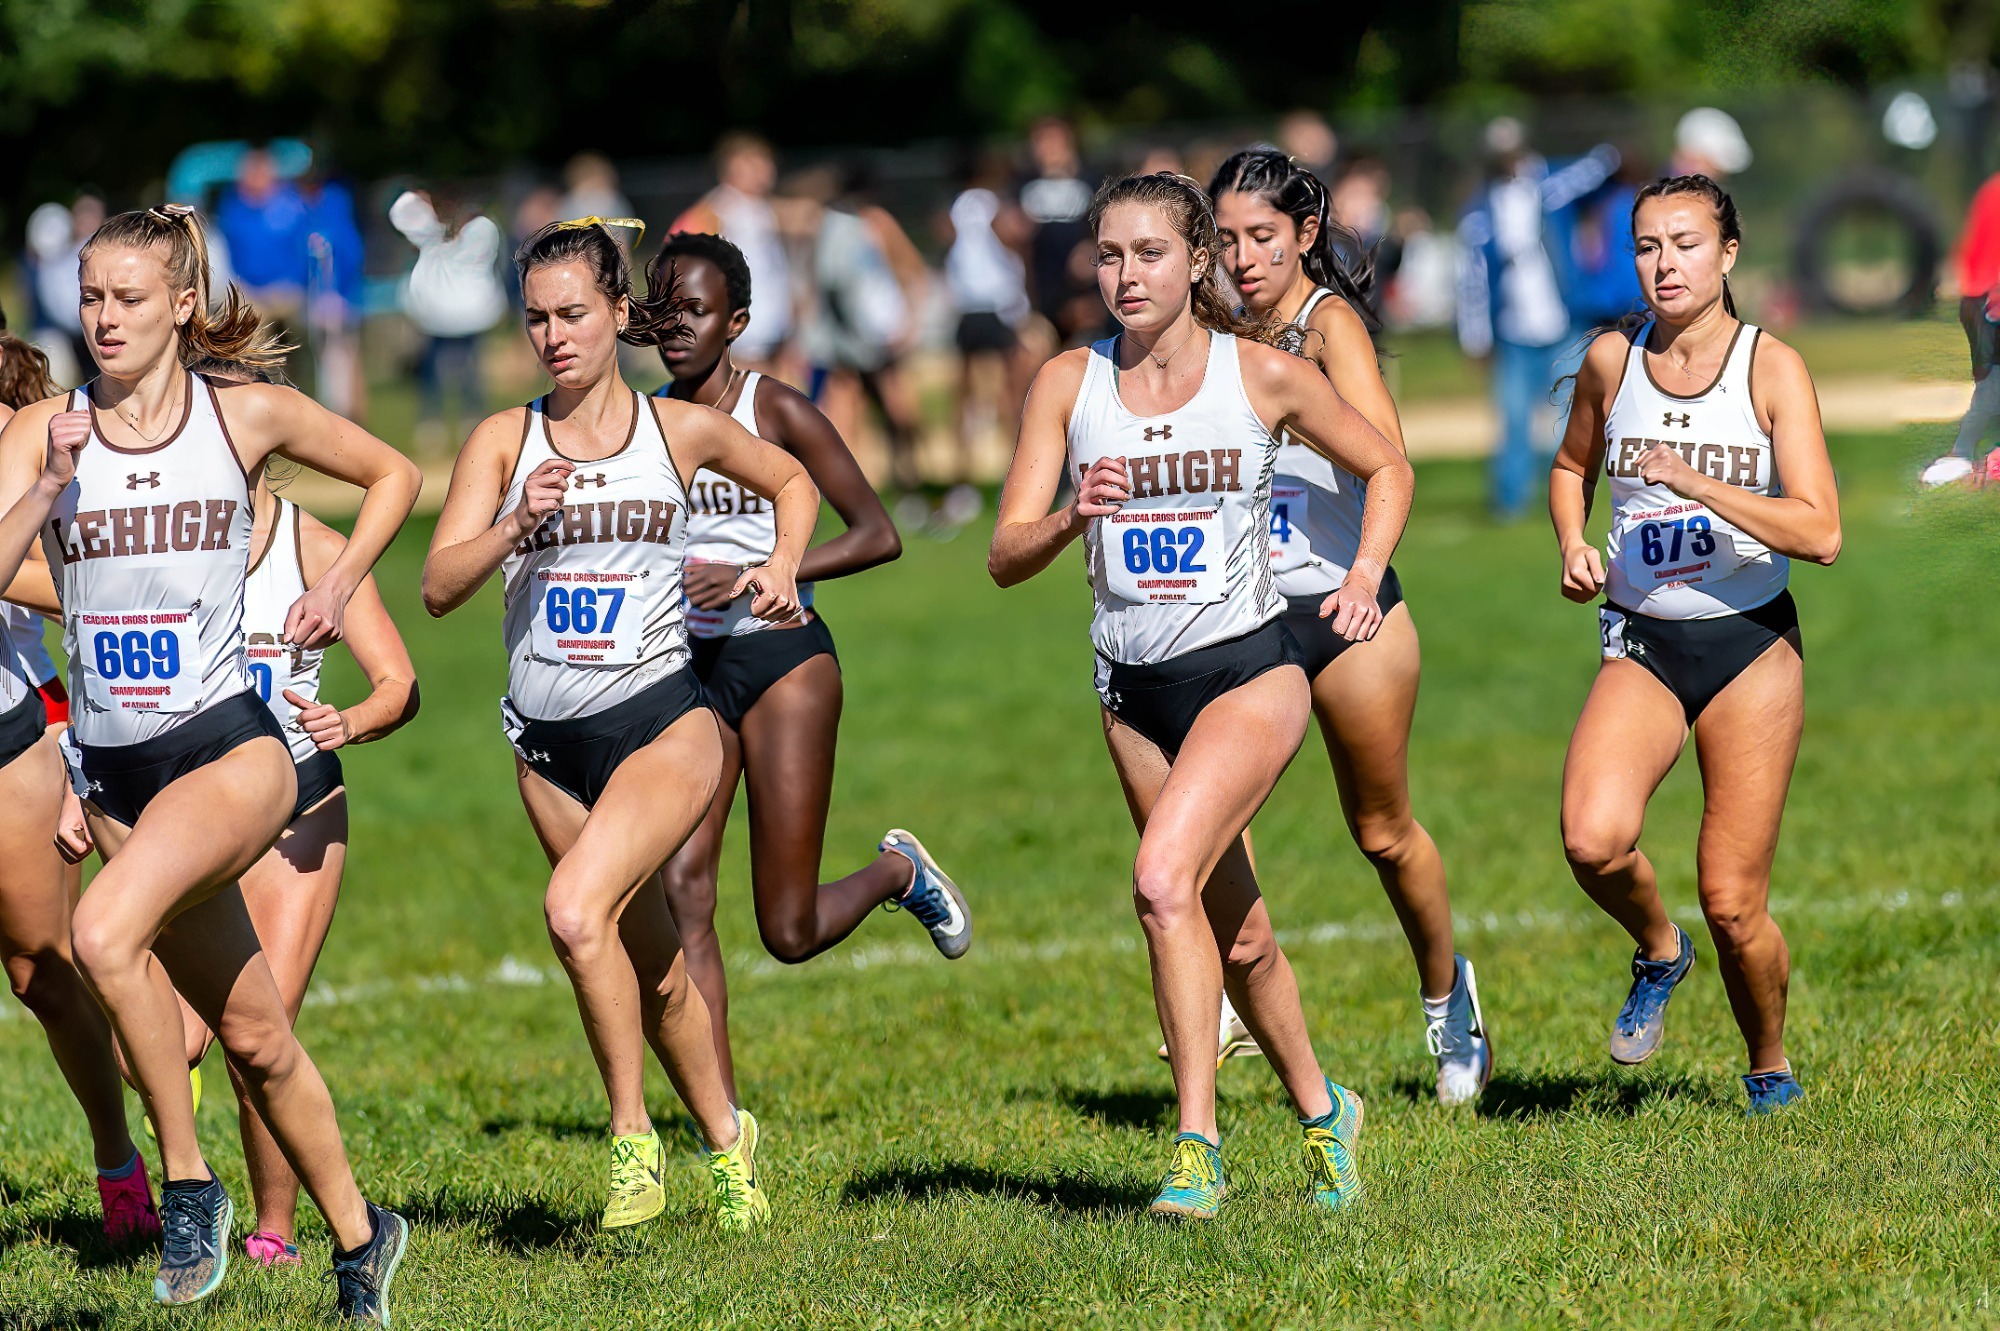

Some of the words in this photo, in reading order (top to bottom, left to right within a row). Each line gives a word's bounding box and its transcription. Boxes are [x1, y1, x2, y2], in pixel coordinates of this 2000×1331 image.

[1079, 449, 1243, 498] HIGH
[1606, 437, 1761, 487] LEIGH
[51, 499, 237, 566] LEHIGH
[1151, 513, 1176, 523] CROSS
[1177, 511, 1213, 522] COUNTRY
[1641, 515, 1716, 567] 673
[1122, 526, 1207, 575] 662
[573, 572, 599, 582] CROSS
[600, 573, 634, 582] COUNTRY
[1137, 579, 1198, 589] CHAMPIONSHIPS
[122, 614, 149, 625] CROSS
[150, 613, 188, 624] COUNTRY
[546, 586, 626, 635] 667
[93, 629, 181, 680] 669
[557, 639, 616, 649] CHAMPIONSHIPS
[109, 685, 171, 696] CHAMPIONSHIPS
